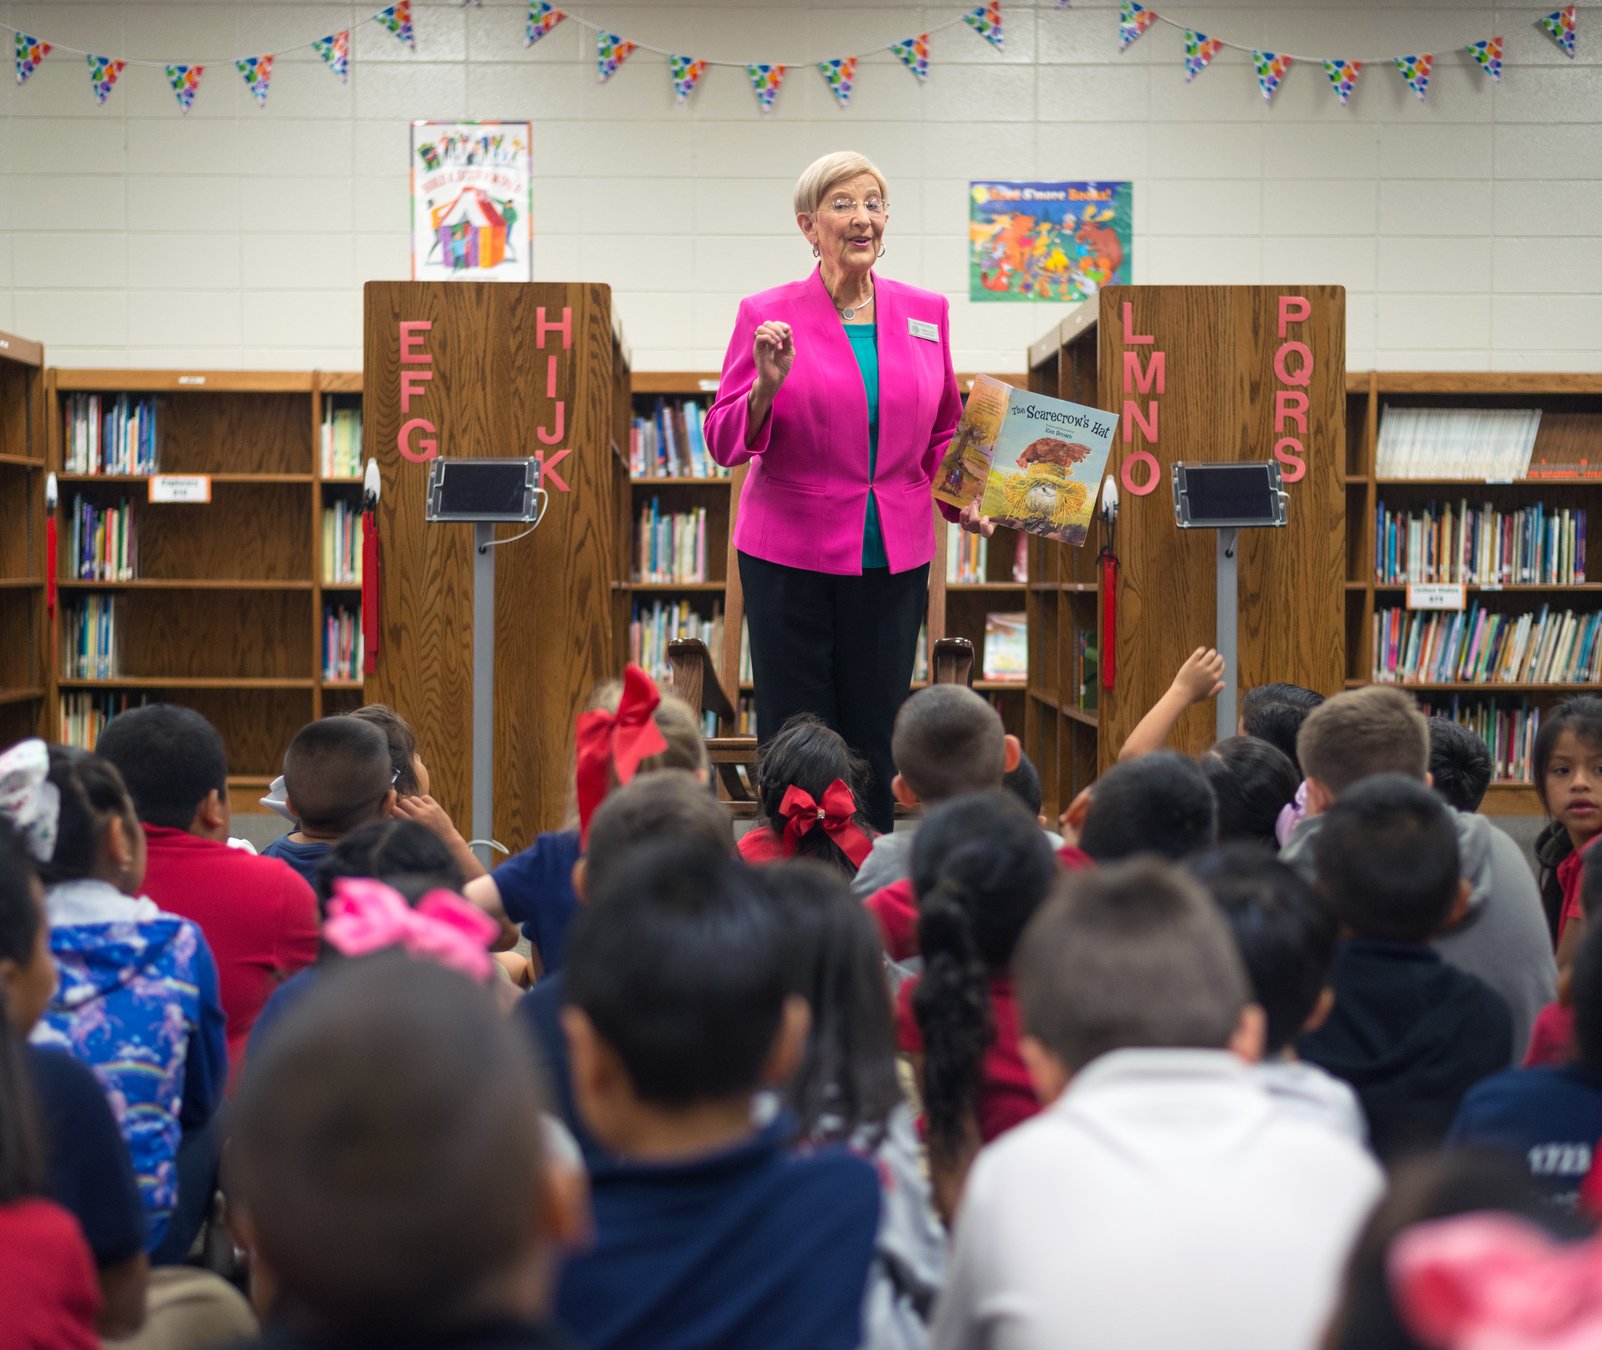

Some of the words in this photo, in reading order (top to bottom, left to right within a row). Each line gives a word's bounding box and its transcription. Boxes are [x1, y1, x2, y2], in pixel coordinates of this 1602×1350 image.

[1011, 405, 1026, 416] The
[1026, 404, 1090, 429] Scarecrow's
[1090, 421, 1111, 439] Hat
